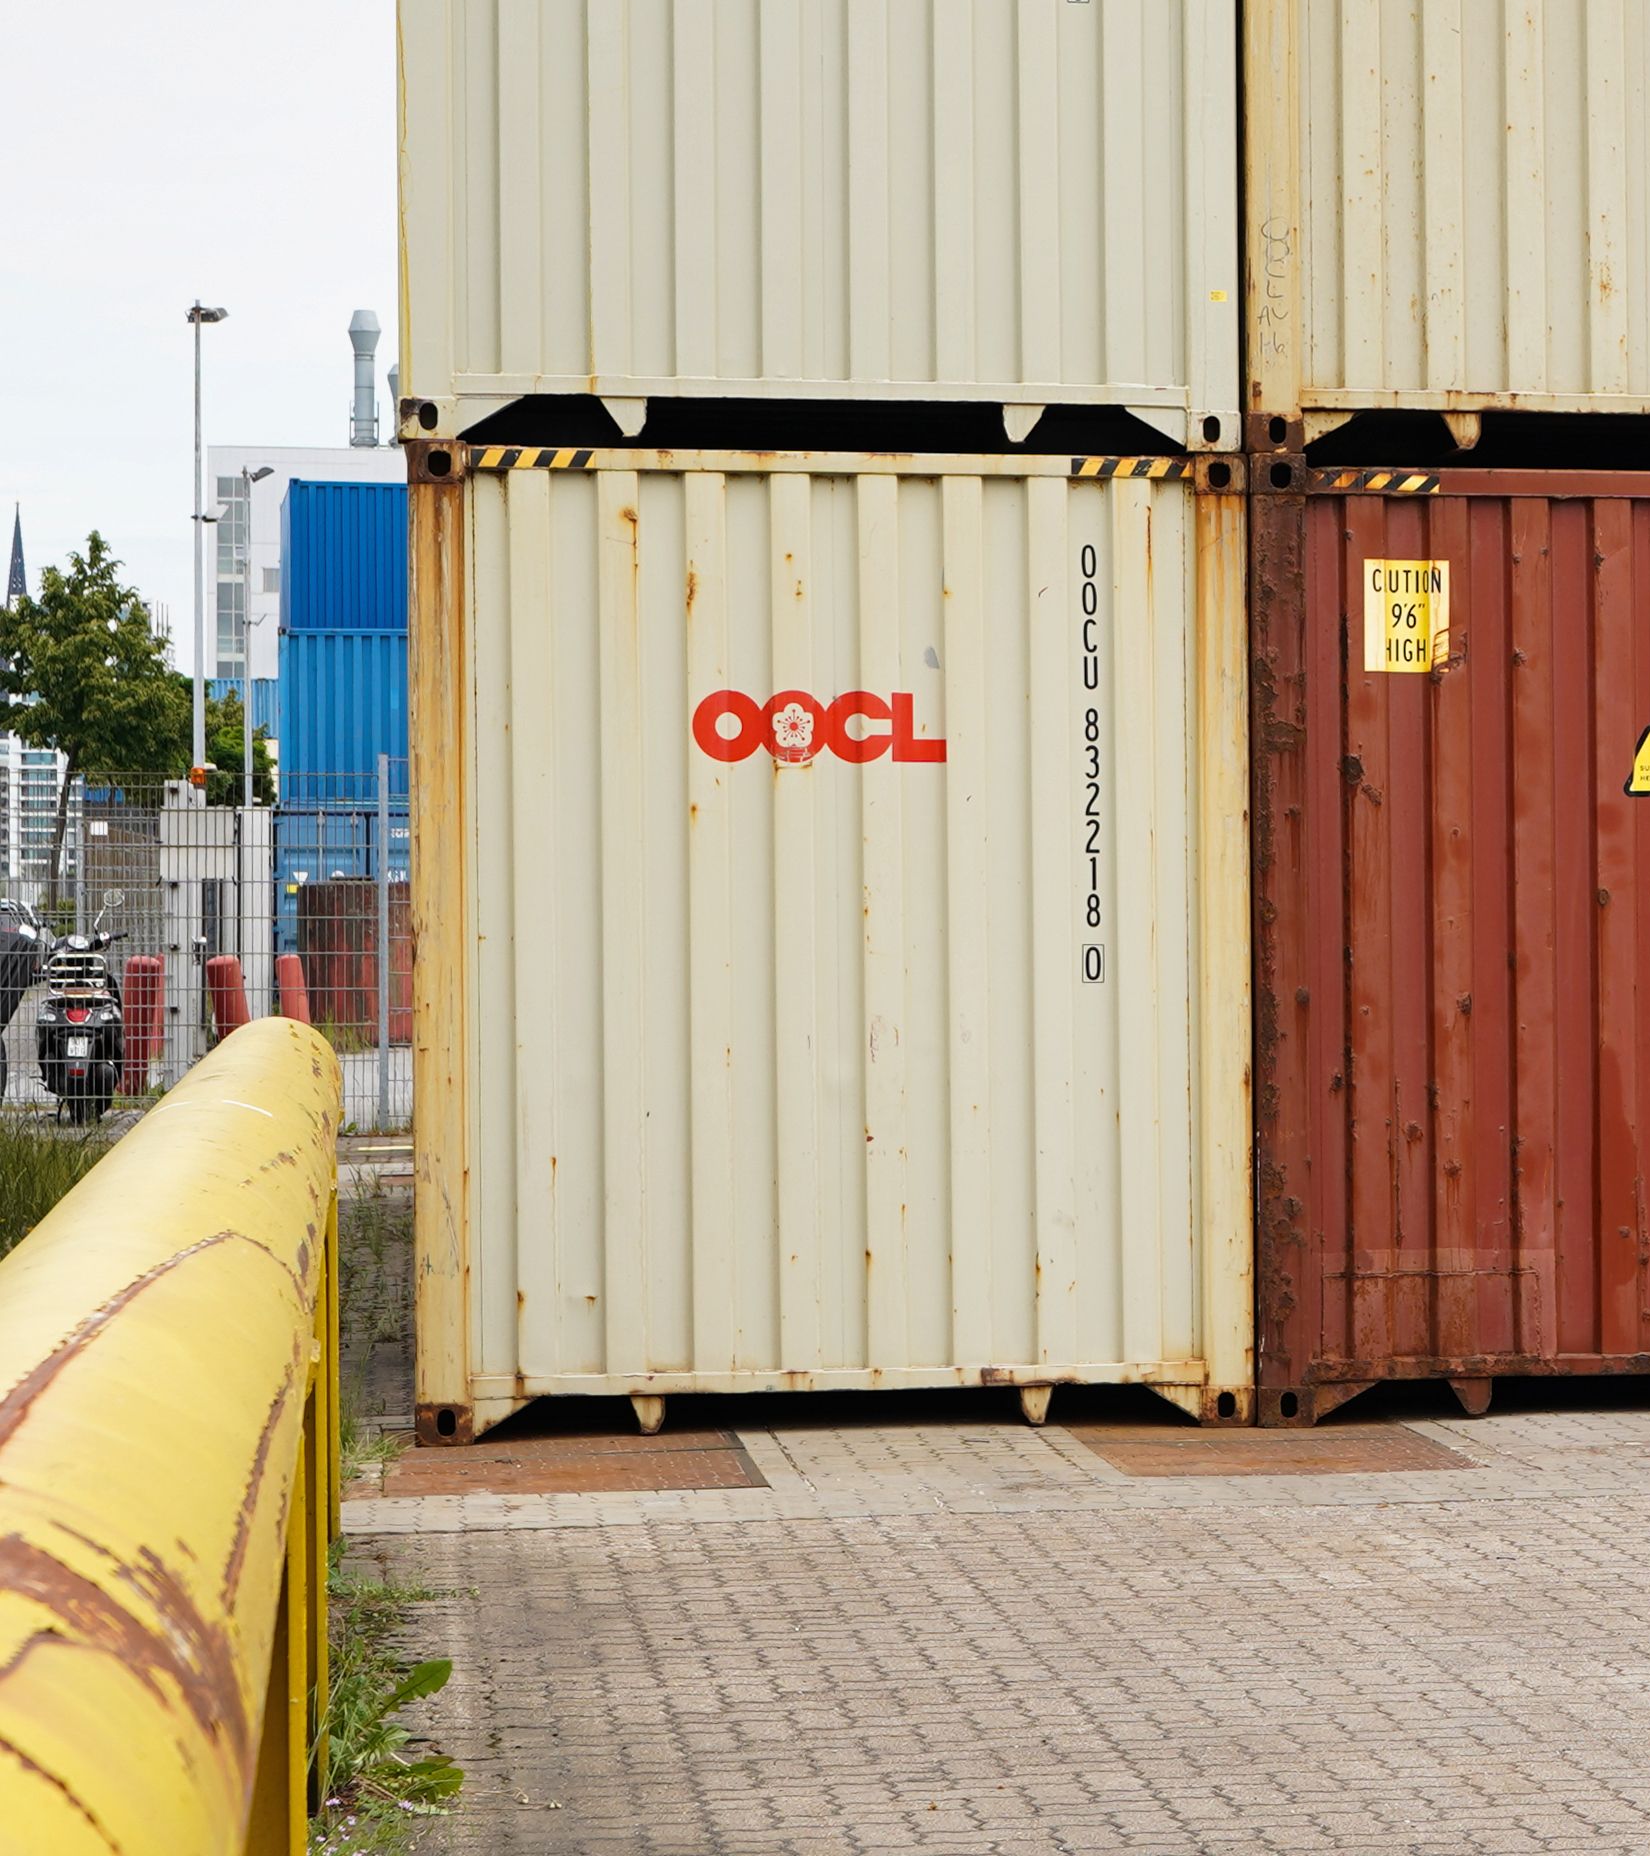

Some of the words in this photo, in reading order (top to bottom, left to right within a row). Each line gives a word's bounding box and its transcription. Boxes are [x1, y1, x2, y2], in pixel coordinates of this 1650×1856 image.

[1081, 544, 1098, 691] OOCU
[1372, 568, 1442, 594] CUTION
[692, 690, 947, 763] OOCL
[1083, 708, 1102, 928] 832218
